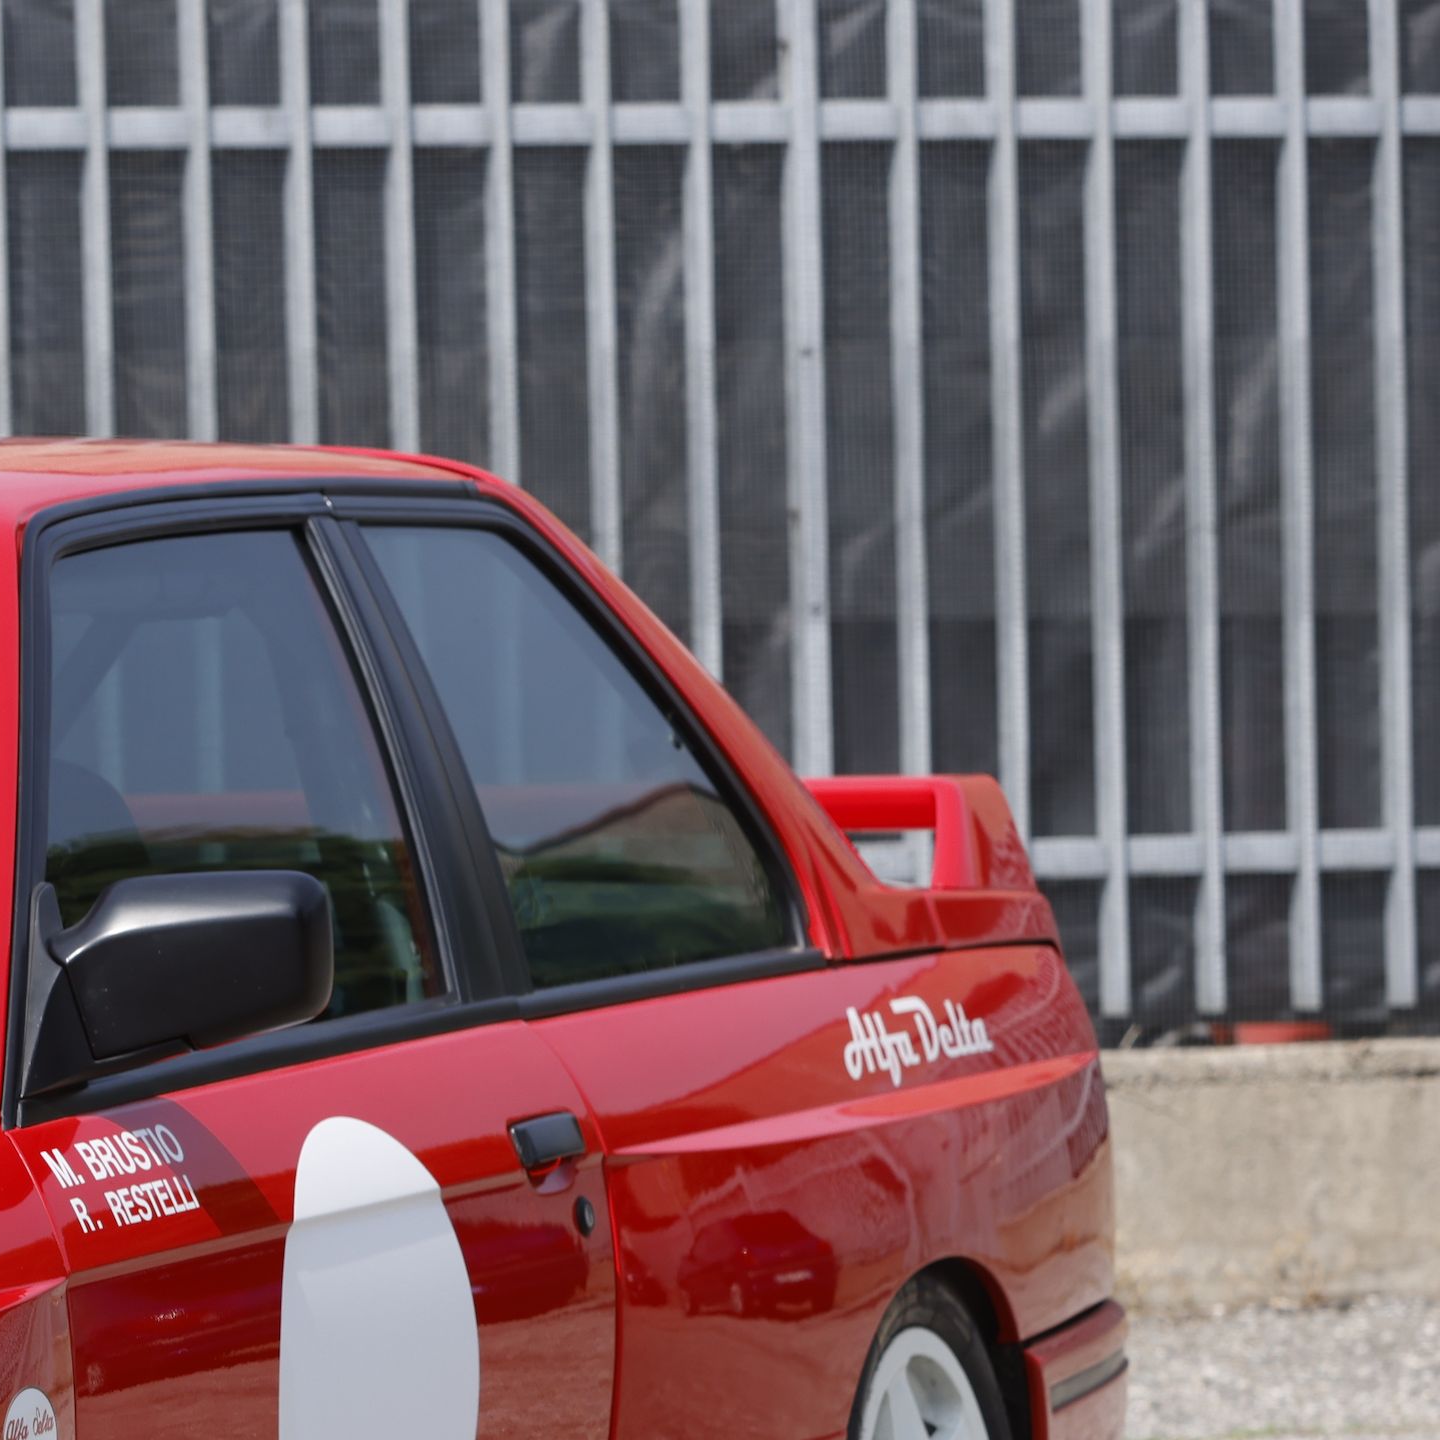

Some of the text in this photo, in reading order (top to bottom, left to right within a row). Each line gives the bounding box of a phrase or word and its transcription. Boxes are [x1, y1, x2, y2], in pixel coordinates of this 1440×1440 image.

[844, 995, 994, 1088] Alfa Delta
[40, 1123, 185, 1189] M. BRUSTIO
[70, 1174, 201, 1234] R. RESTELLI
